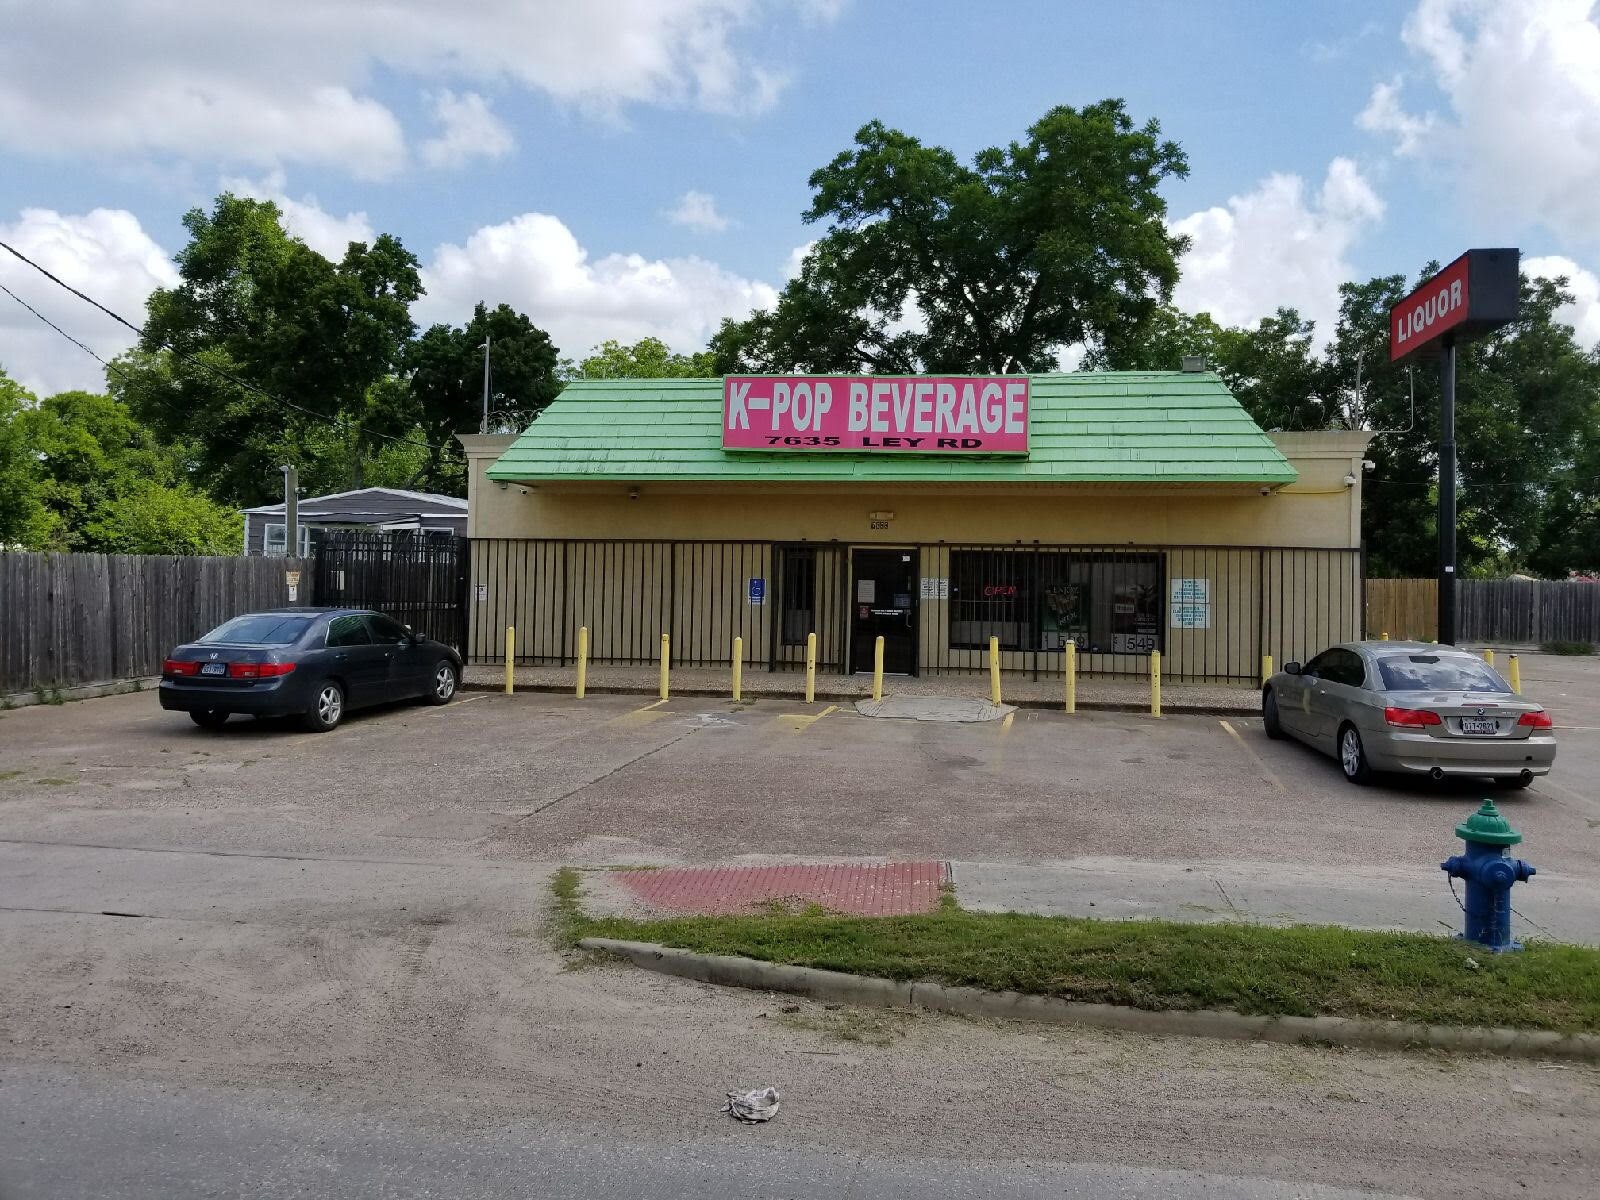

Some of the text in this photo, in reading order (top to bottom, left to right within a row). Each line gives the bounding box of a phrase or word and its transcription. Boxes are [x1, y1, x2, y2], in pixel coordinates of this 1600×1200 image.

[1398, 279, 1462, 343] LIQUOR
[728, 382, 1026, 434] K-POP BEVERAGE
[764, 436, 983, 449] 7635 LEY RD
[984, 585, 1017, 596] OPEN
